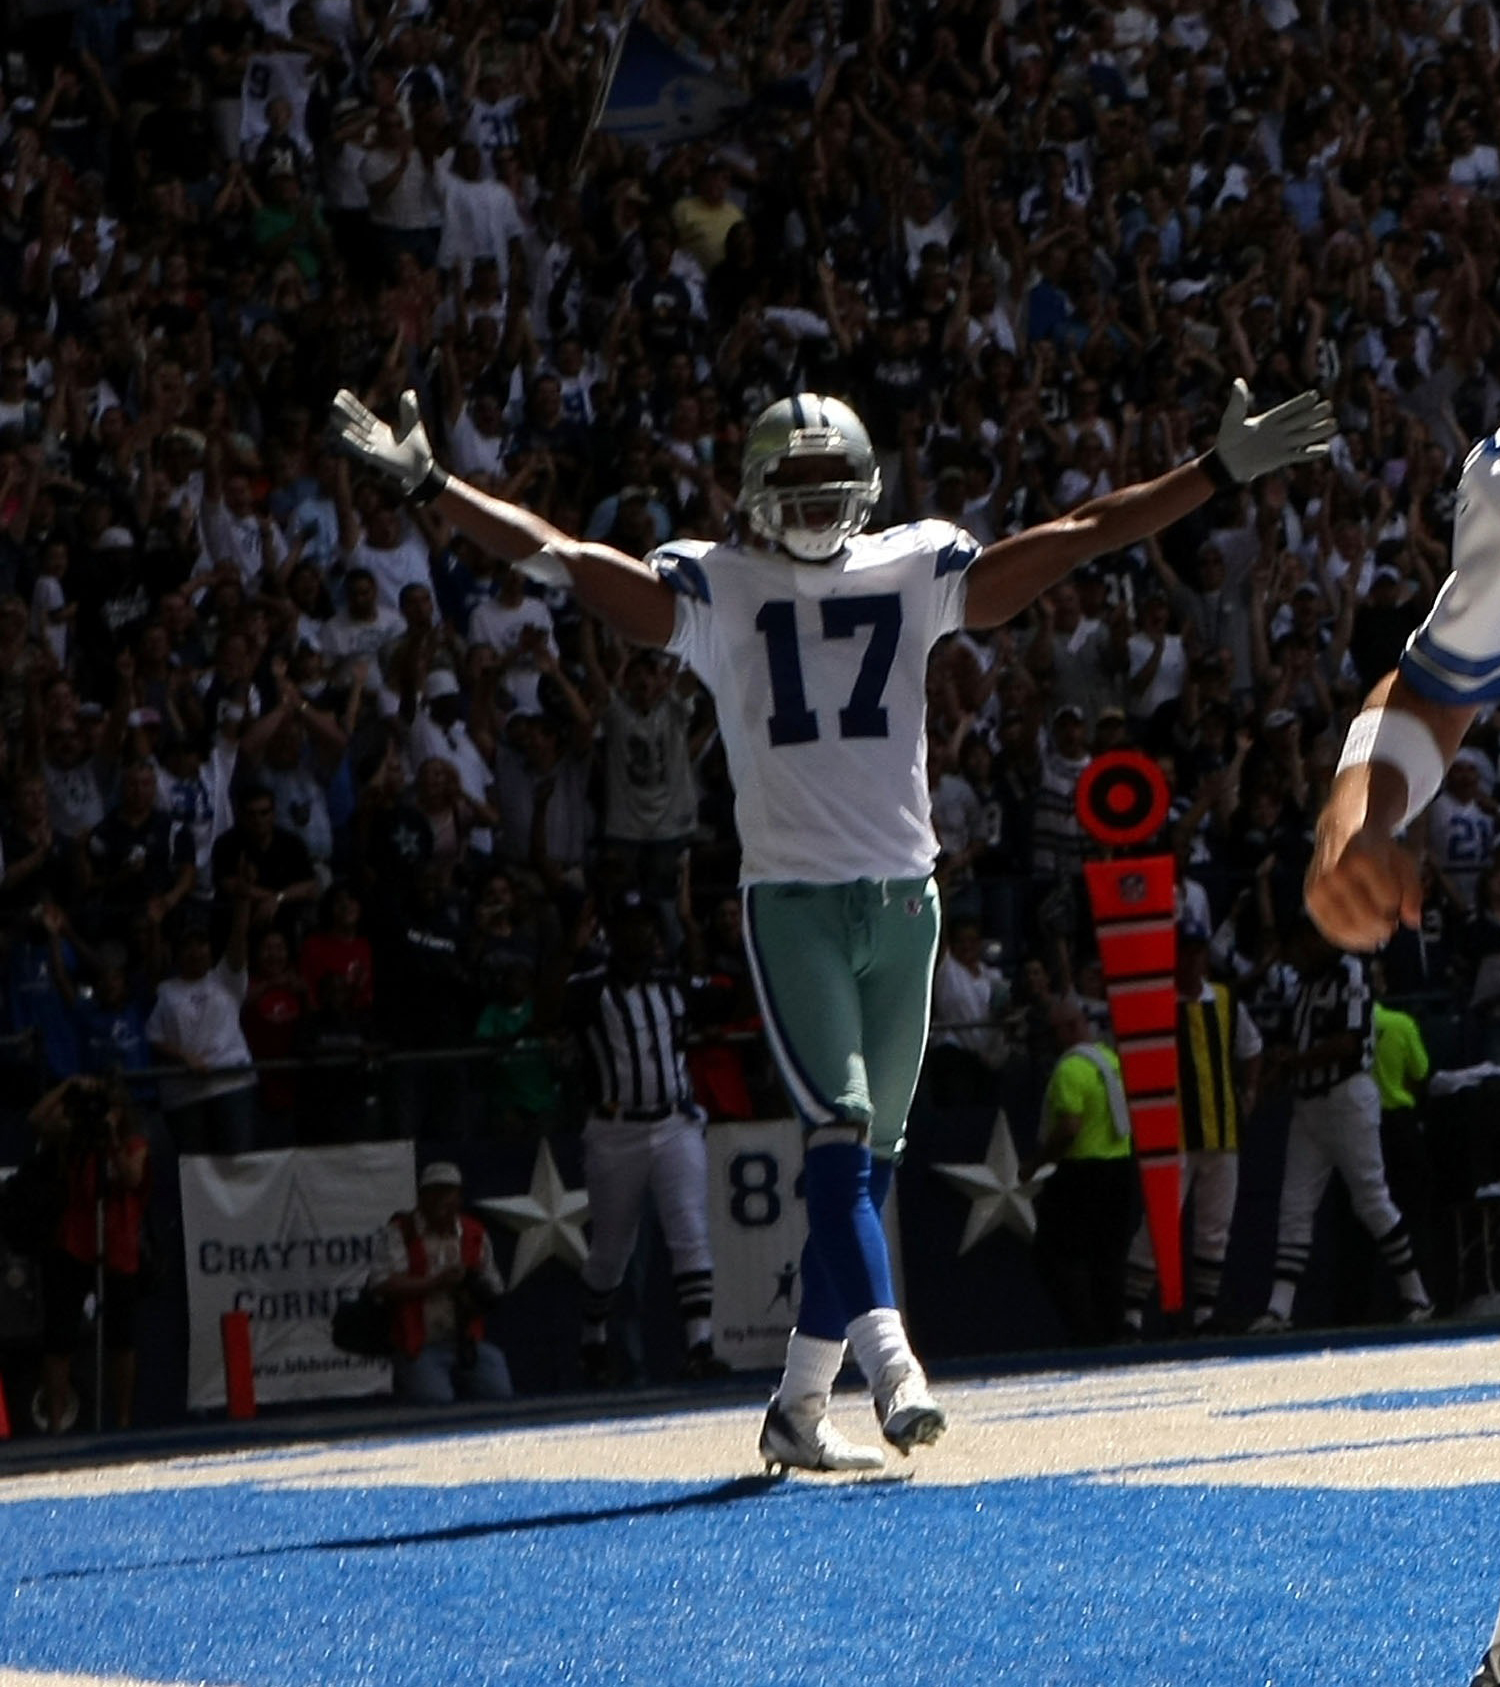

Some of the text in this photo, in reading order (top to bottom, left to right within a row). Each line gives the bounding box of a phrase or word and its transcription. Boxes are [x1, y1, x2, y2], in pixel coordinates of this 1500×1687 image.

[756, 594, 902, 748] 17
[1448, 818, 1490, 863] 21
[730, 1153, 806, 1226] 8
